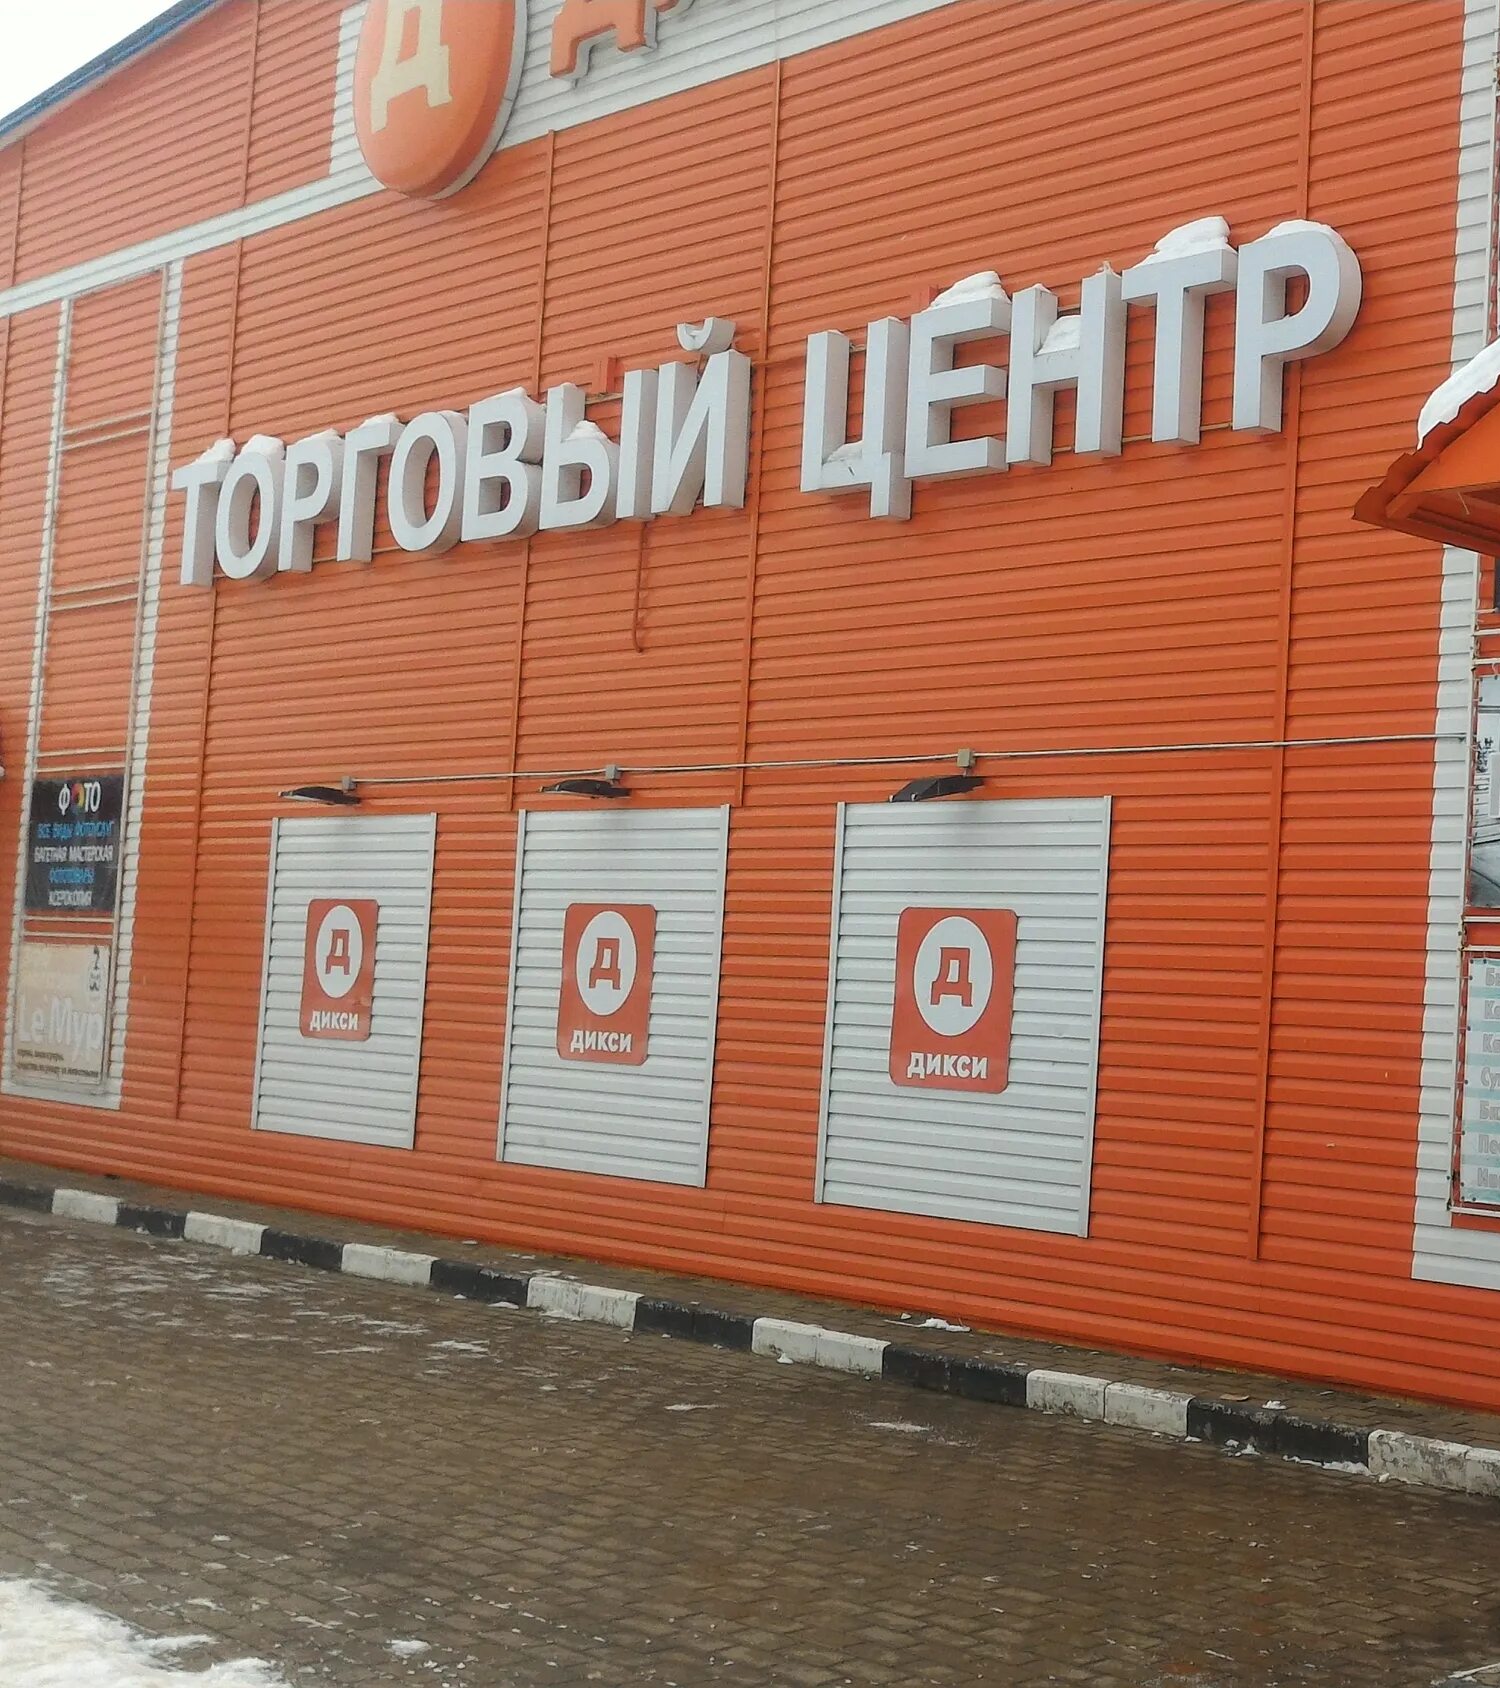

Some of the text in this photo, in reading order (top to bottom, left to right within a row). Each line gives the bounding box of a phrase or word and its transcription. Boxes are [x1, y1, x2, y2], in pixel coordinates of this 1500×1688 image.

[172, 228, 1363, 587] ТОРГОВЫЙ ЦЕНТР
[58, 781, 102, 816] ФОТО
[309, 1009, 359, 1031] ДИКСИ
[570, 1029, 632, 1054] ДИКСИ
[907, 1052, 988, 1080] ДИКСИ
